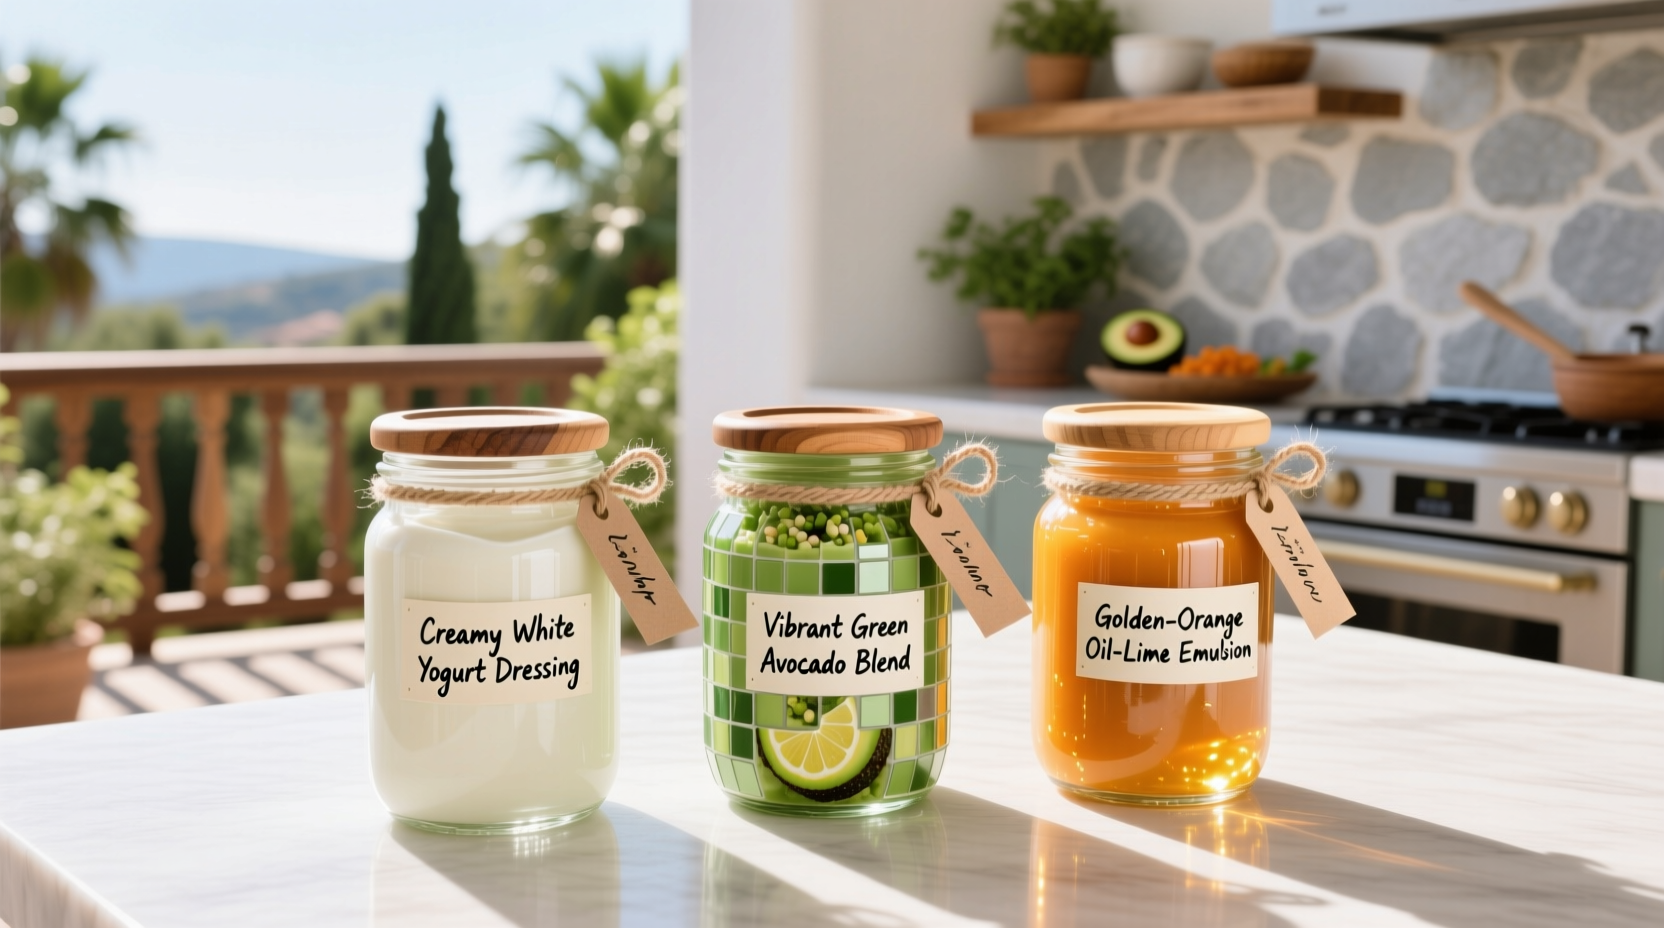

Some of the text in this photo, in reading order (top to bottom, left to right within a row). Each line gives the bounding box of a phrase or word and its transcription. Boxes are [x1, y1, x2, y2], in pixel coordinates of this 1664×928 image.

[420, 612, 575, 657] Creamy White
[763, 611, 908, 639] Vibrant Green
[1095, 603, 1244, 639] Golden-Orange
[760, 644, 911, 675] Avocado Blend
[1085, 636, 1251, 663] Oil-Lime Emulsion
[418, 655, 580, 698] Yogurt Dressing
